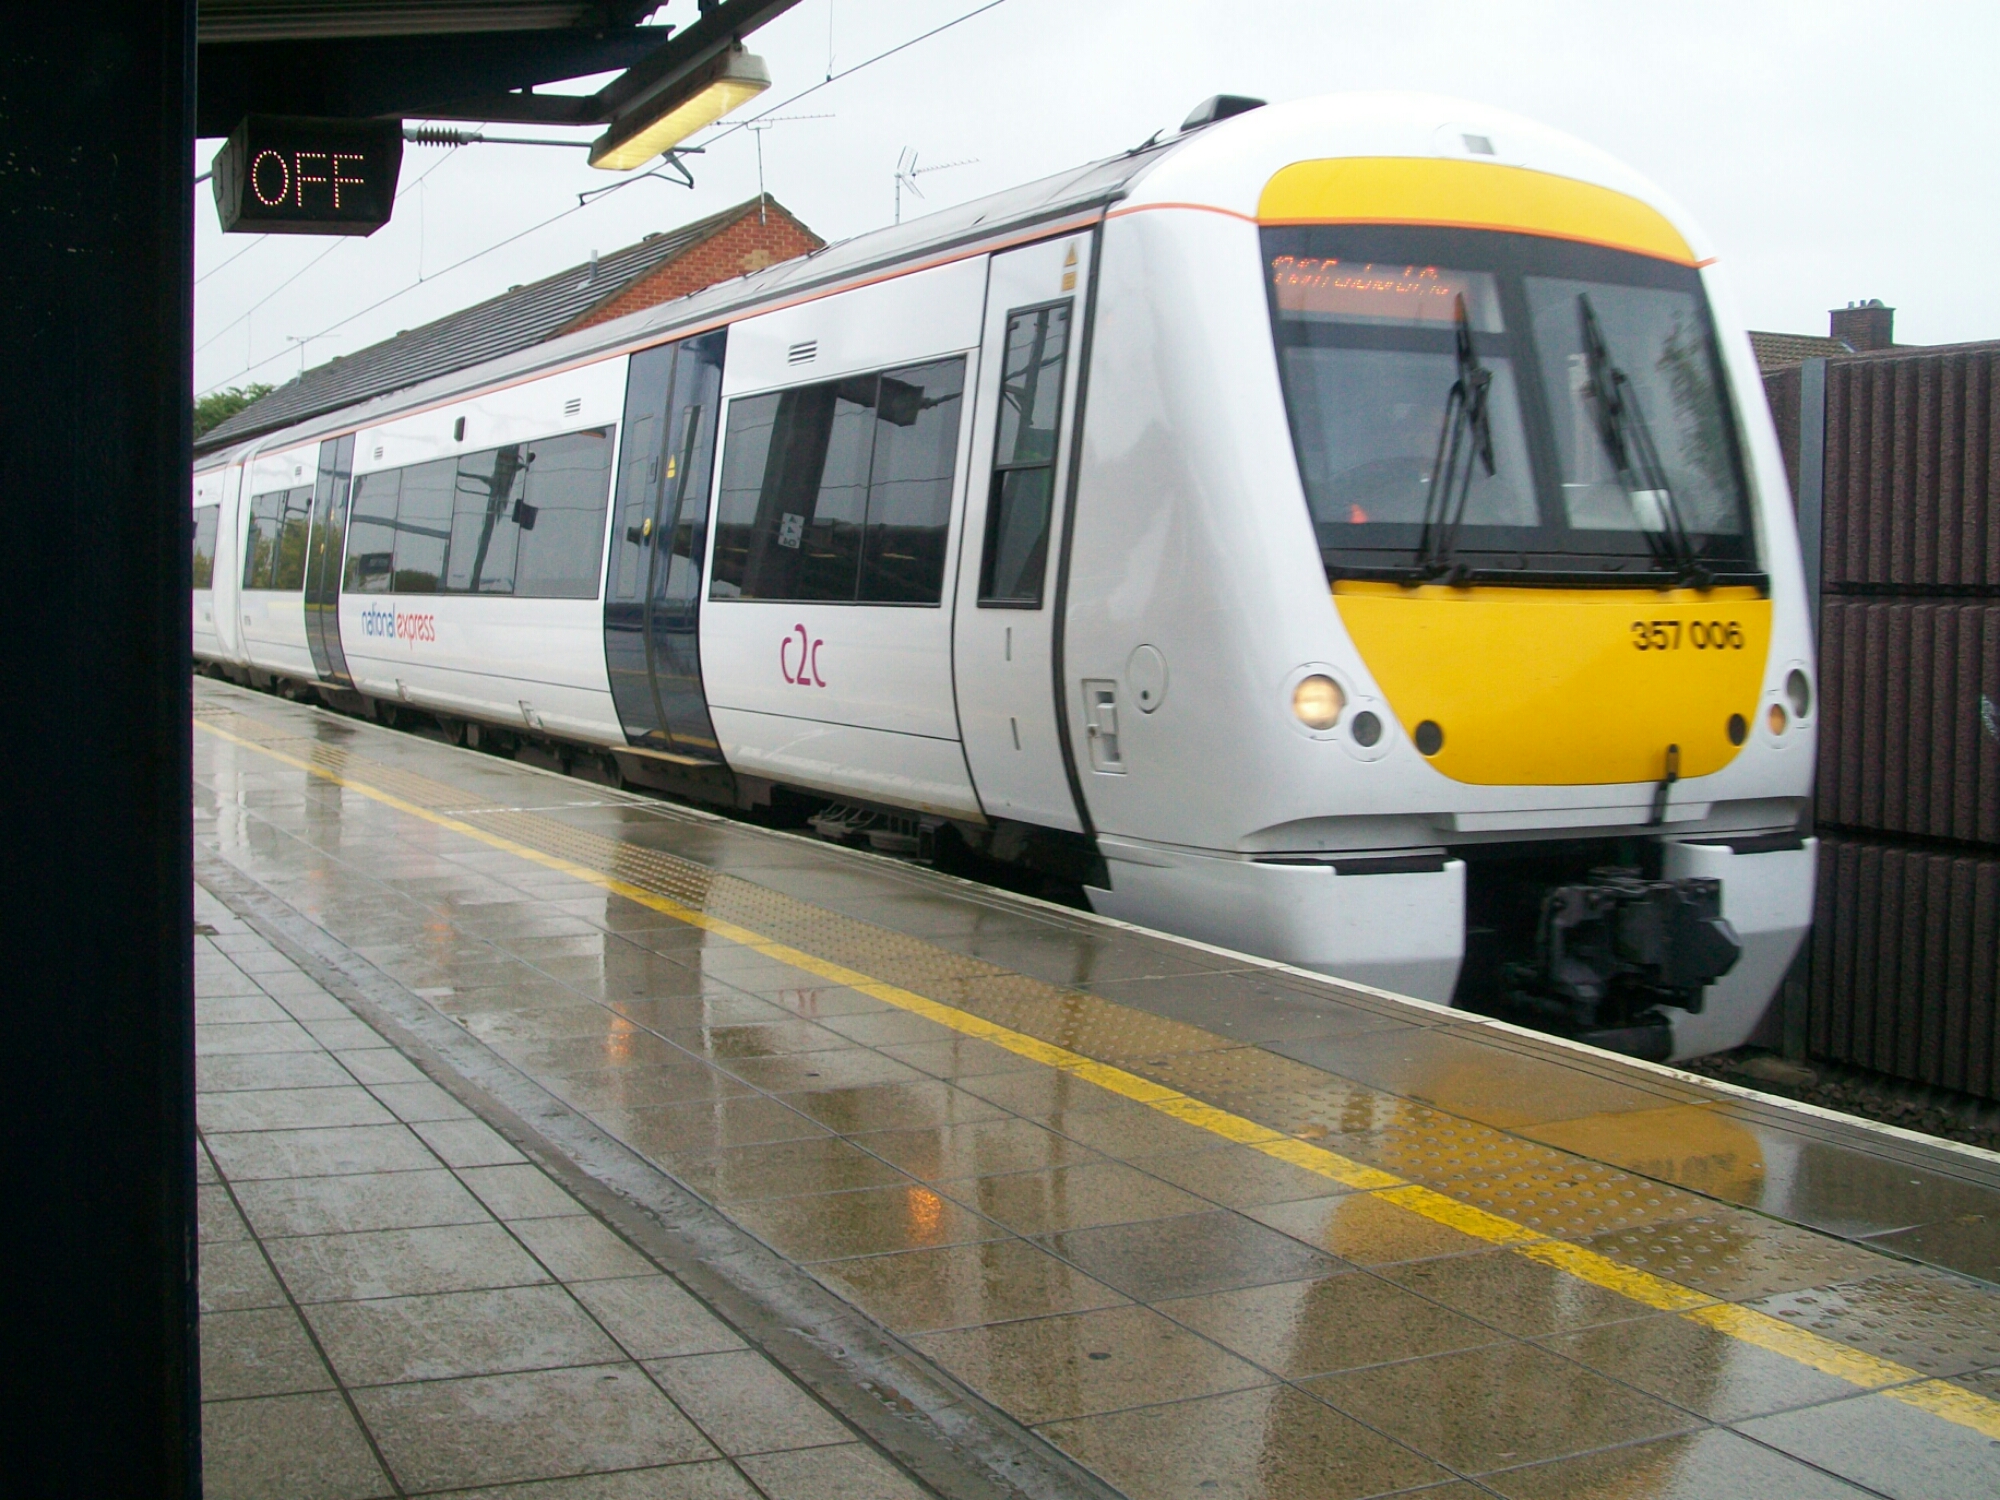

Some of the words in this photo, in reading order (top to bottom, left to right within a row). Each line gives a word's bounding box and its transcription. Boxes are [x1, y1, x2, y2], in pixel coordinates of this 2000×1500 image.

[252, 149, 364, 208] OFF
[361, 602, 396, 638] national
[397, 613, 435, 650] express
[1631, 620, 1682, 651] 357
[1689, 620, 1745, 650] 006
[780, 623, 827, 688] c2c
